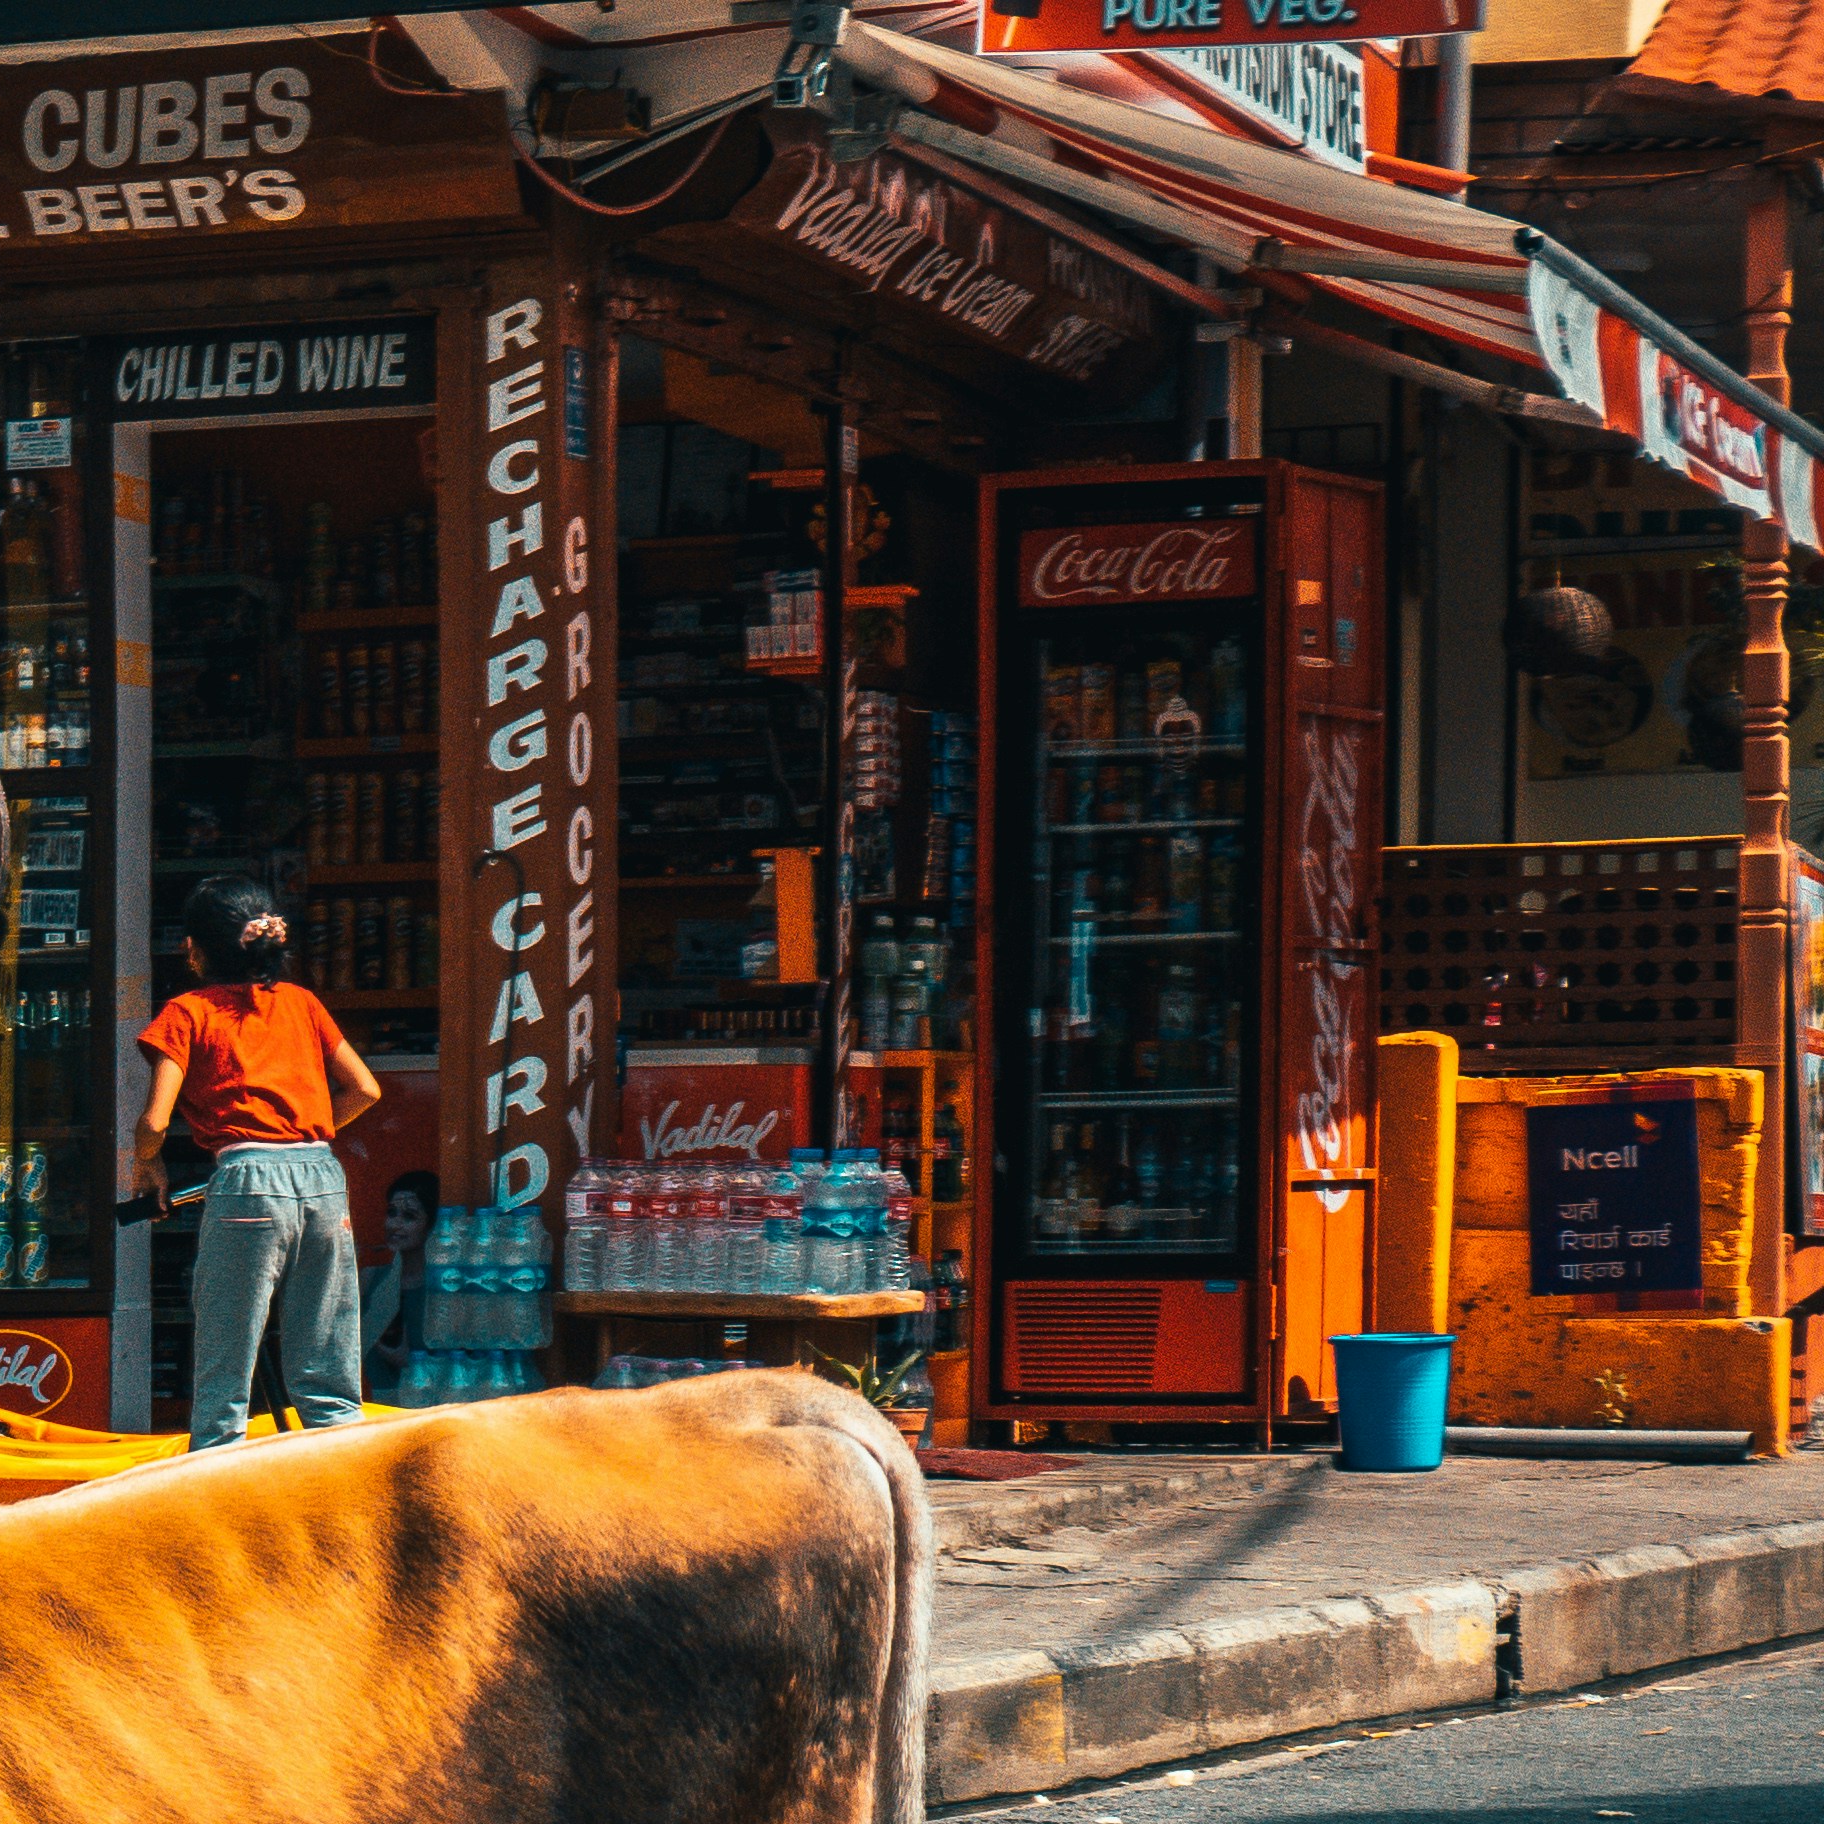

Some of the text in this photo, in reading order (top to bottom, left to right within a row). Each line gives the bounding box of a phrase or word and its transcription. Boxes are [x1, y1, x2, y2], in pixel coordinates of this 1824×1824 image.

[21, 66, 313, 173] CUBES
[24, 167, 307, 238] BEER'S
[116, 333, 407, 402] CHILLED WINE
[486, 298, 549, 851] RECHARGE
[563, 515, 596, 1159] GROCERY
[486, 892, 550, 1213] CARD
[642, 1100, 779, 1160] Vadilal
[1562, 1145, 1639, 1171] Ncell
